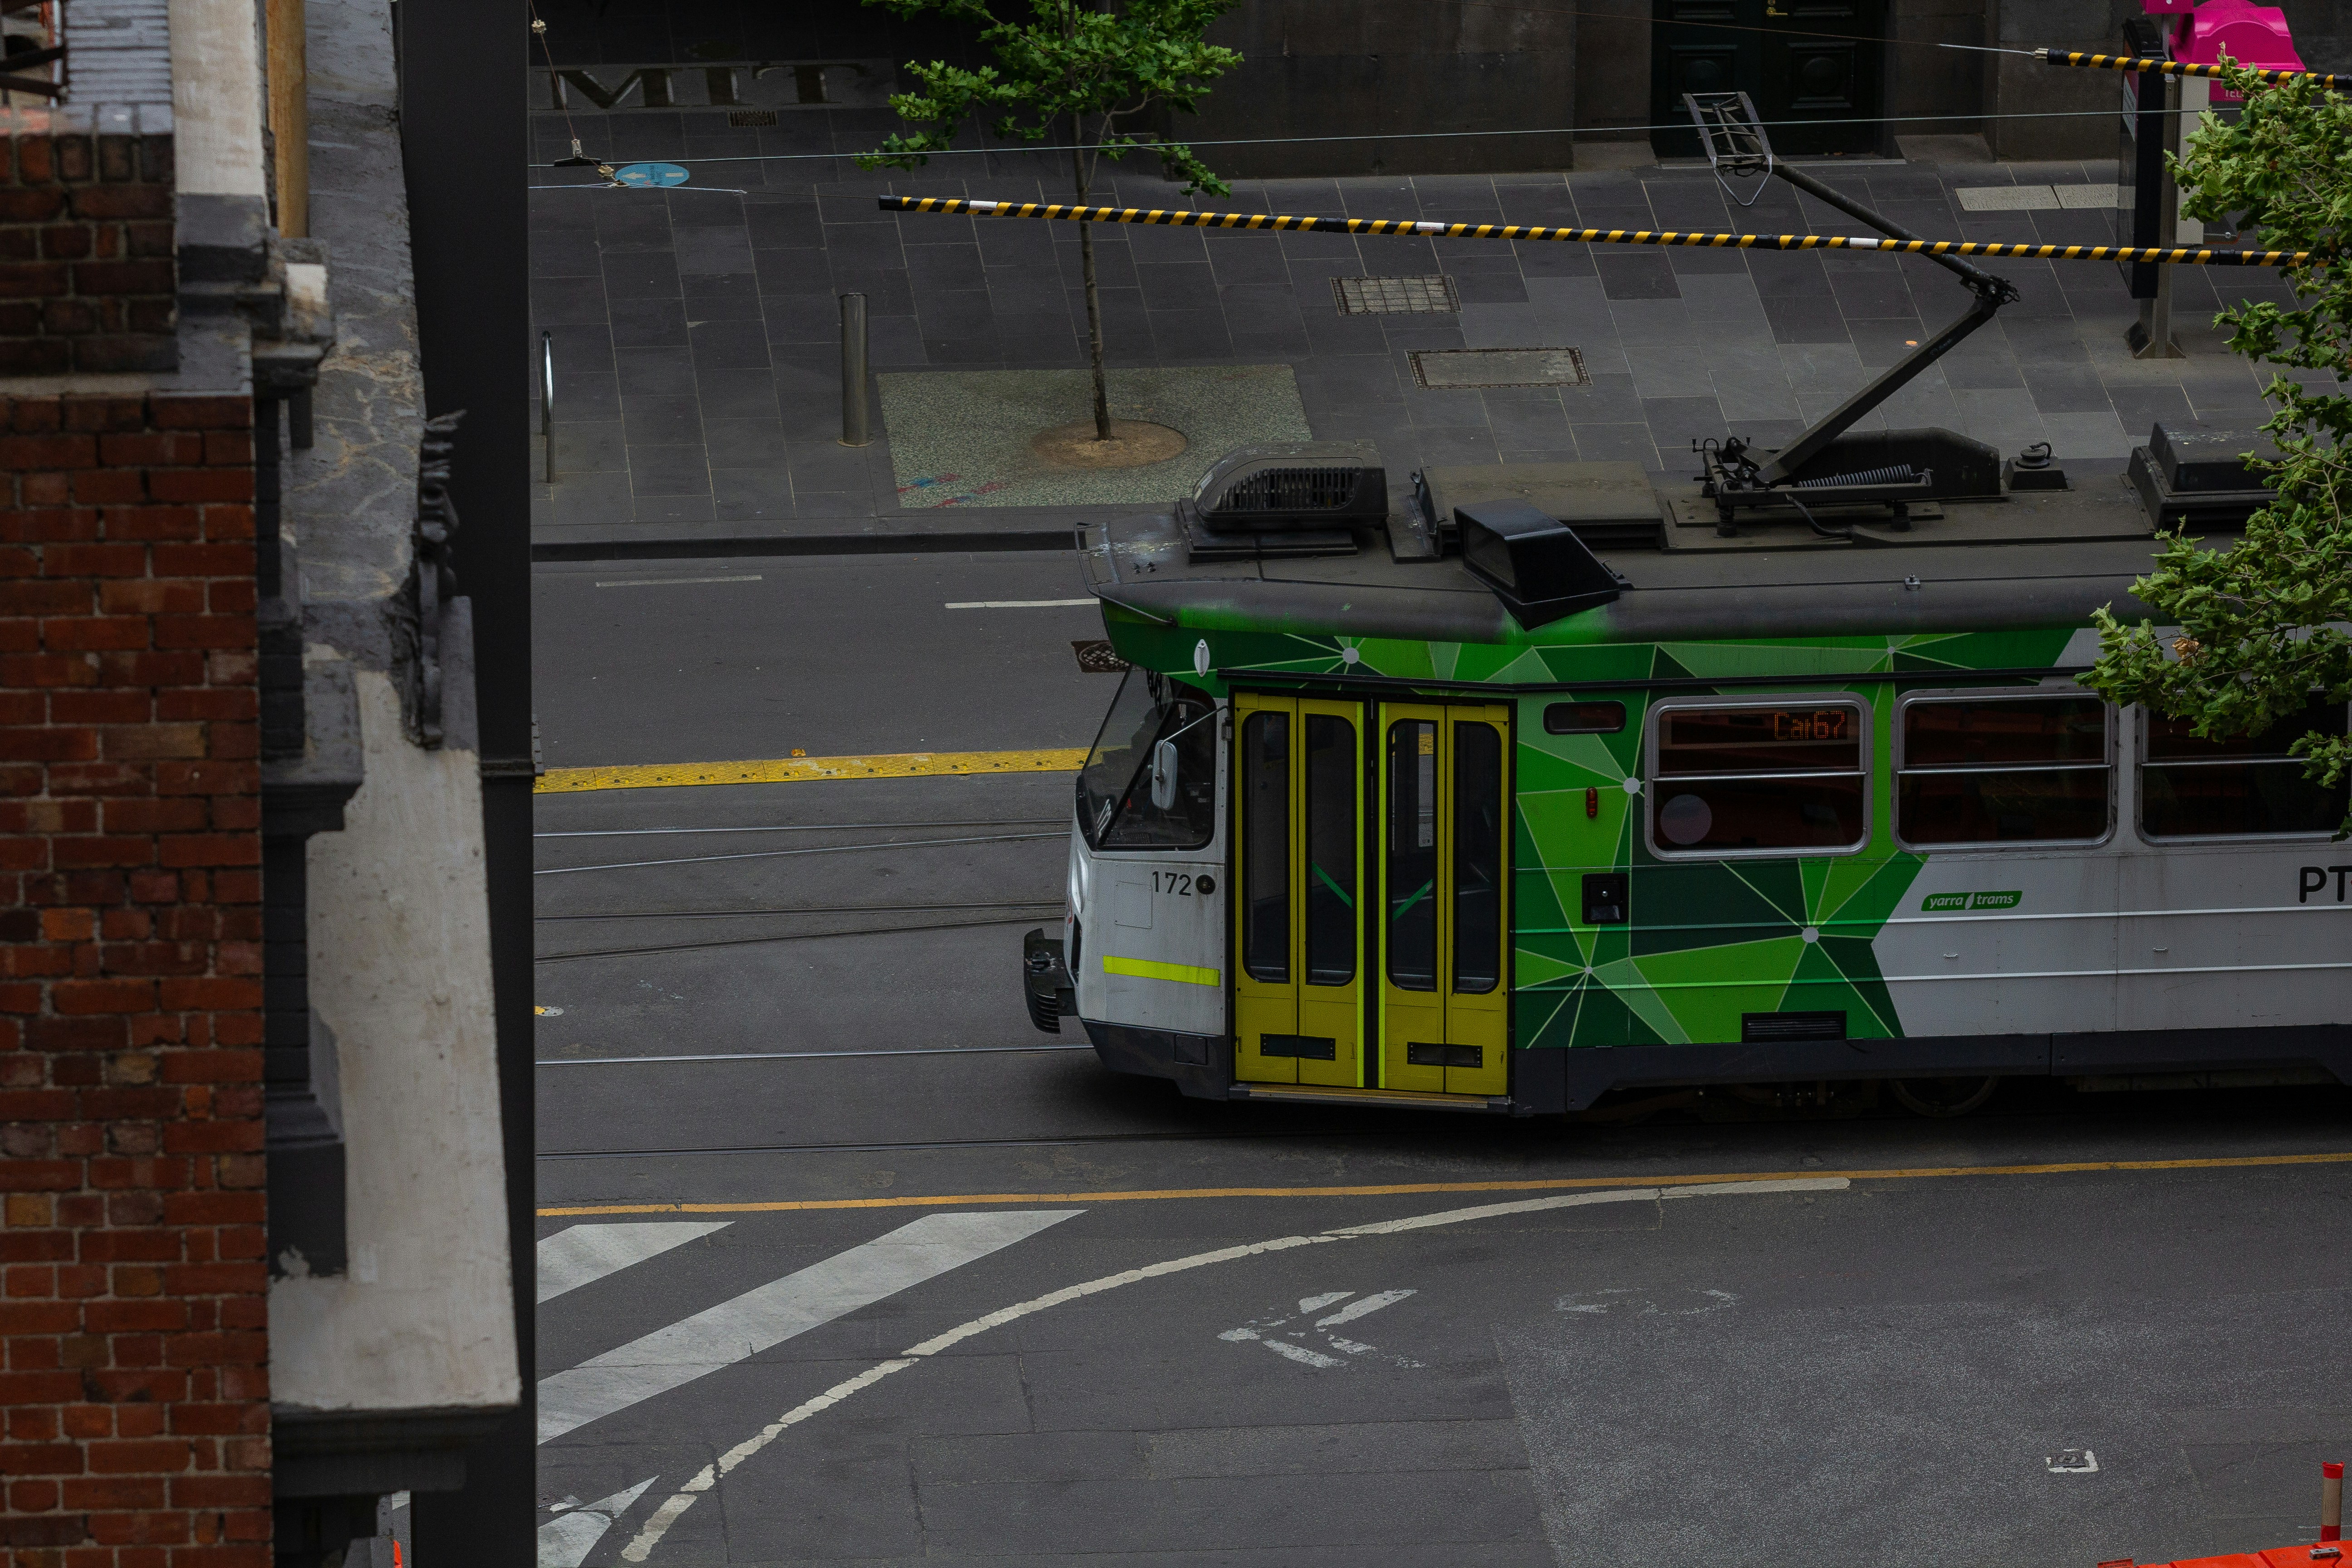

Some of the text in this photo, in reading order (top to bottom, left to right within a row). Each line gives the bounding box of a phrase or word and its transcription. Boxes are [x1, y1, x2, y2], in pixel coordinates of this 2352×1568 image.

[1152, 871, 1191, 897] 172
[1929, 894, 2014, 909] yarra trams
